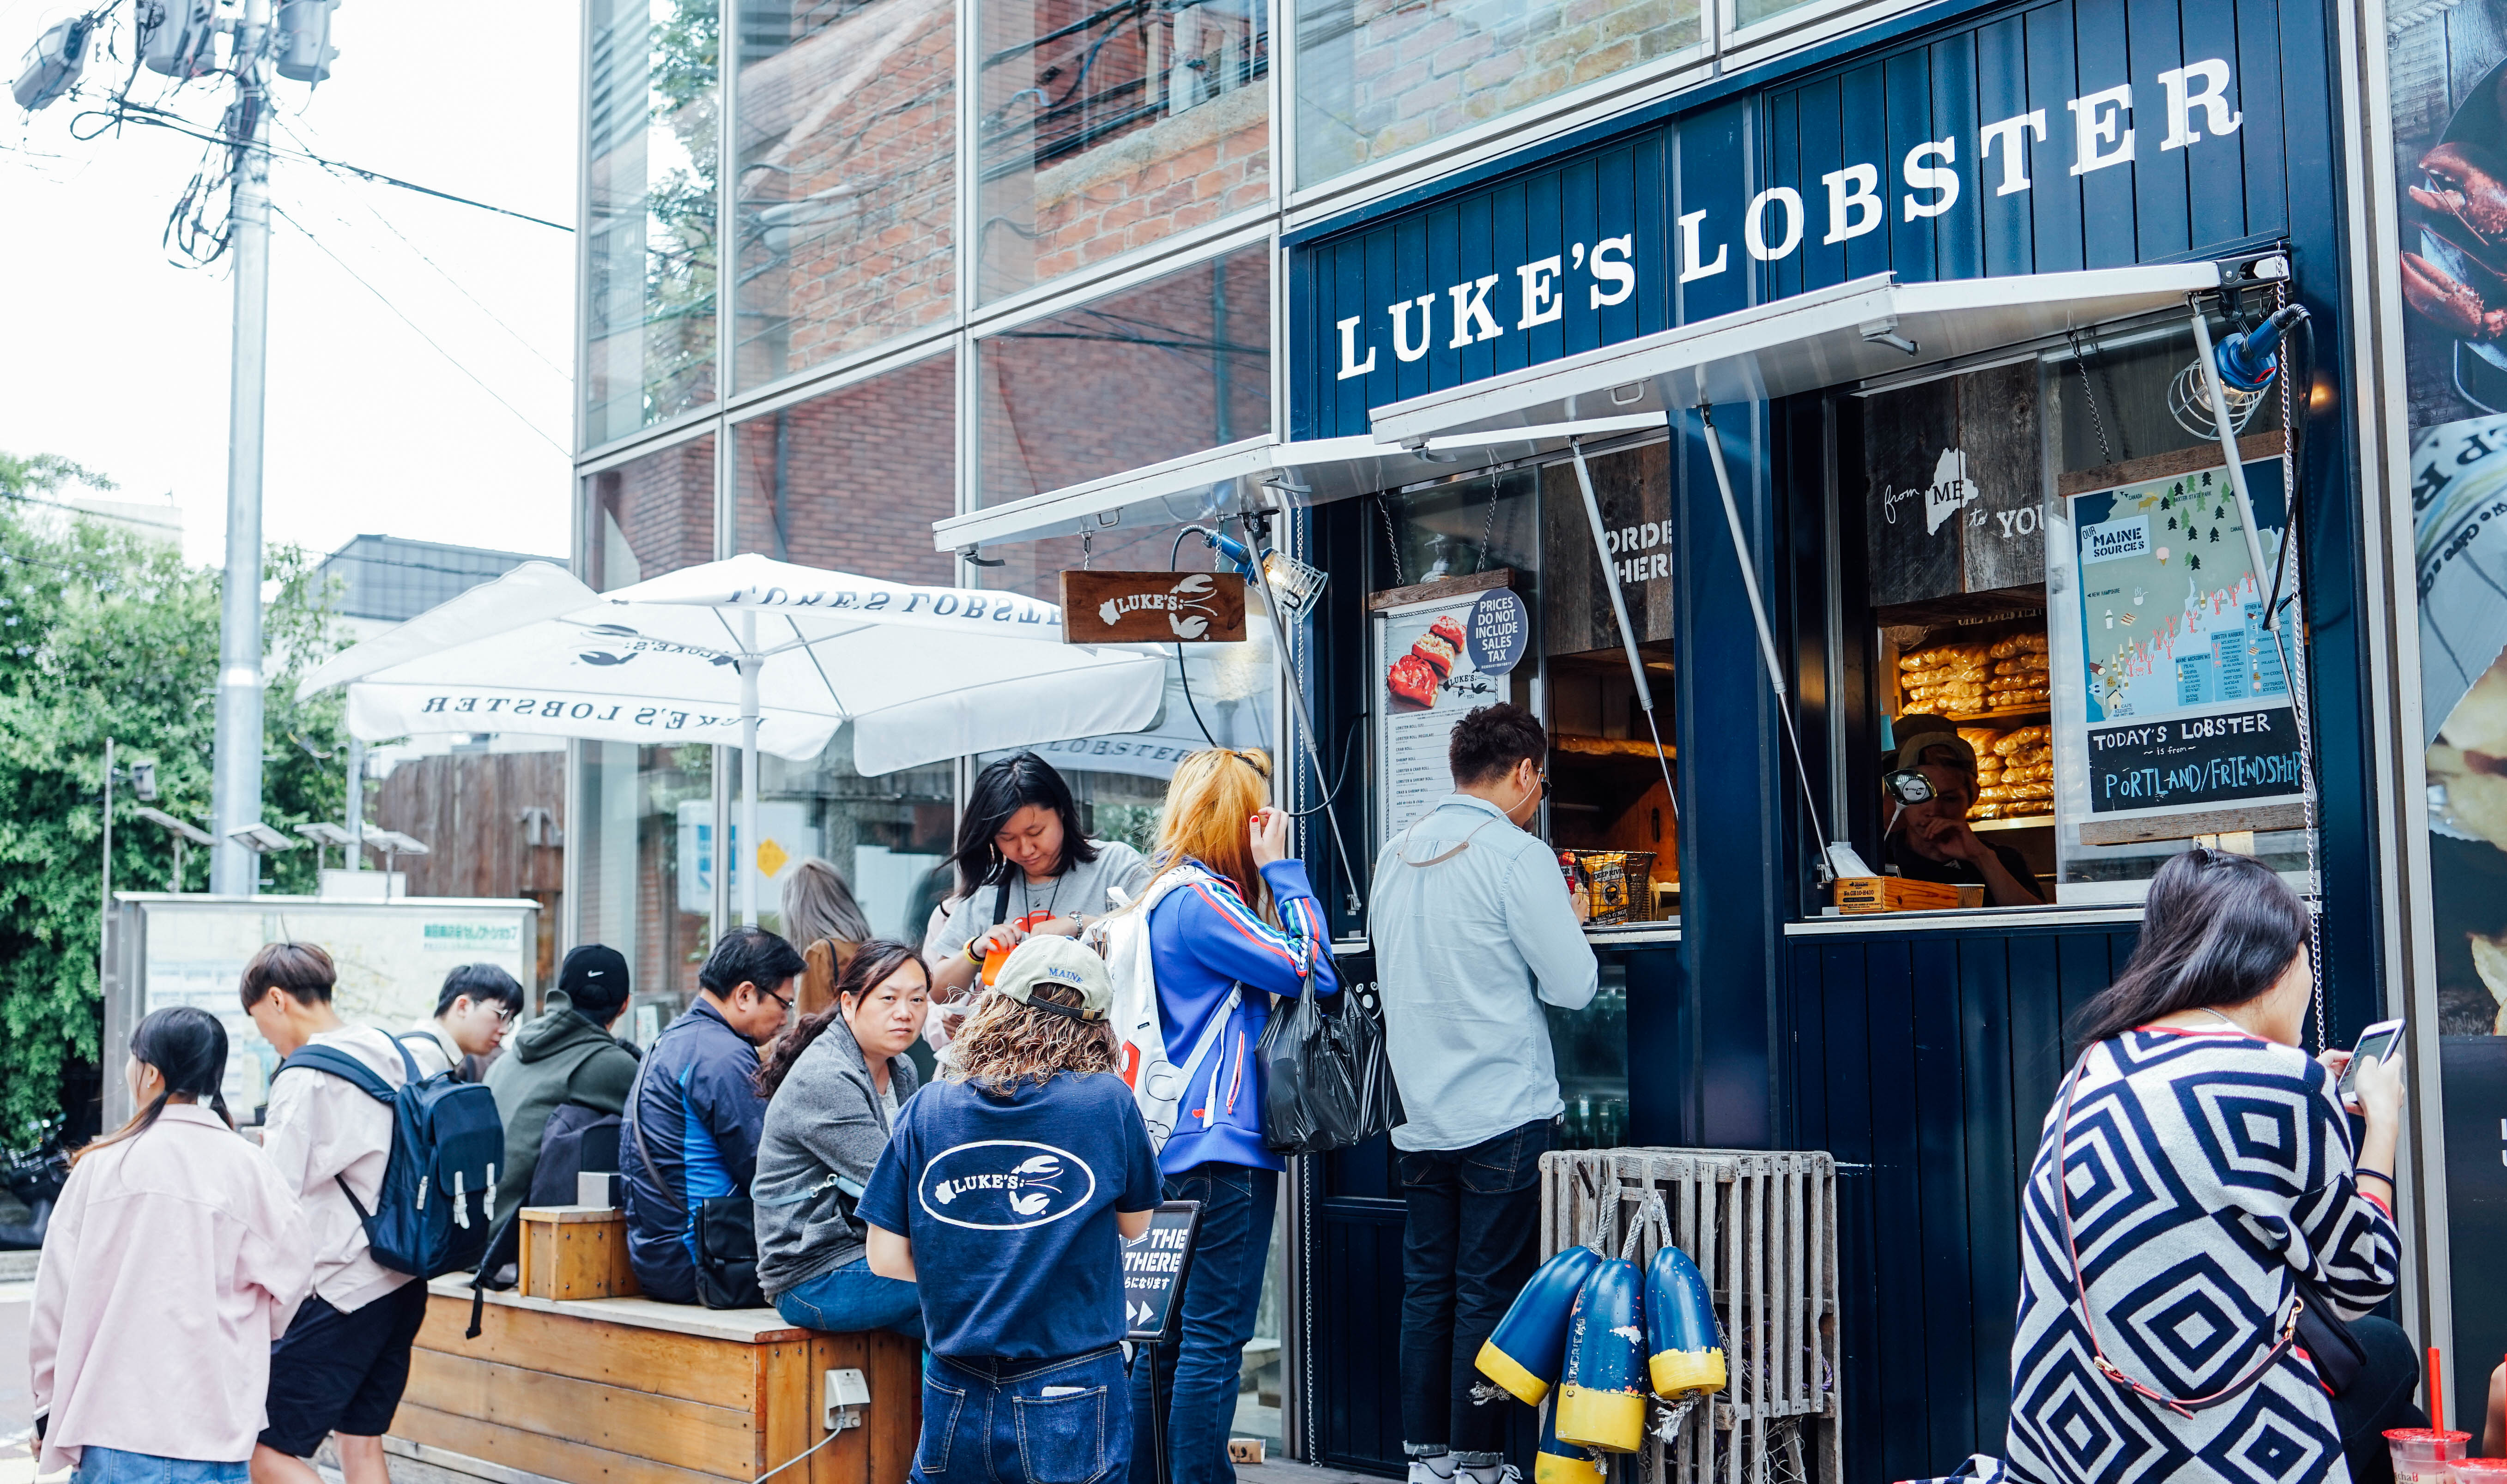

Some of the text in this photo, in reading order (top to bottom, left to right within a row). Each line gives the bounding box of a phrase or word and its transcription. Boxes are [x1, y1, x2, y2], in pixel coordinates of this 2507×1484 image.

[1336, 57, 2243, 382] LUKE'S LOBSTER
[1933, 480, 1964, 505] ME
[1884, 484, 1920, 524] from
[1969, 508, 1987, 527] to
[2083, 526, 2096, 539] OUR
[2093, 528, 2142, 547] MAINE
[2094, 541, 2144, 557] SOURCES
[1480, 597, 1513, 613] PRICES
[1478, 609, 1515, 626] DO NOT
[1476, 622, 1518, 639] INCLUDE
[1482, 636, 1511, 650] SALES
[1488, 650, 1506, 662] TAX
[2093, 713, 2271, 751] TODAY'S LOBSTER
[2157, 746, 2187, 755] is from
[1594, 871, 1608, 880] DEEP
[1049, 968, 1083, 983] MAINE
[1151, 1229, 1188, 1249] THE
[1124, 1252, 1182, 1273] THERE
